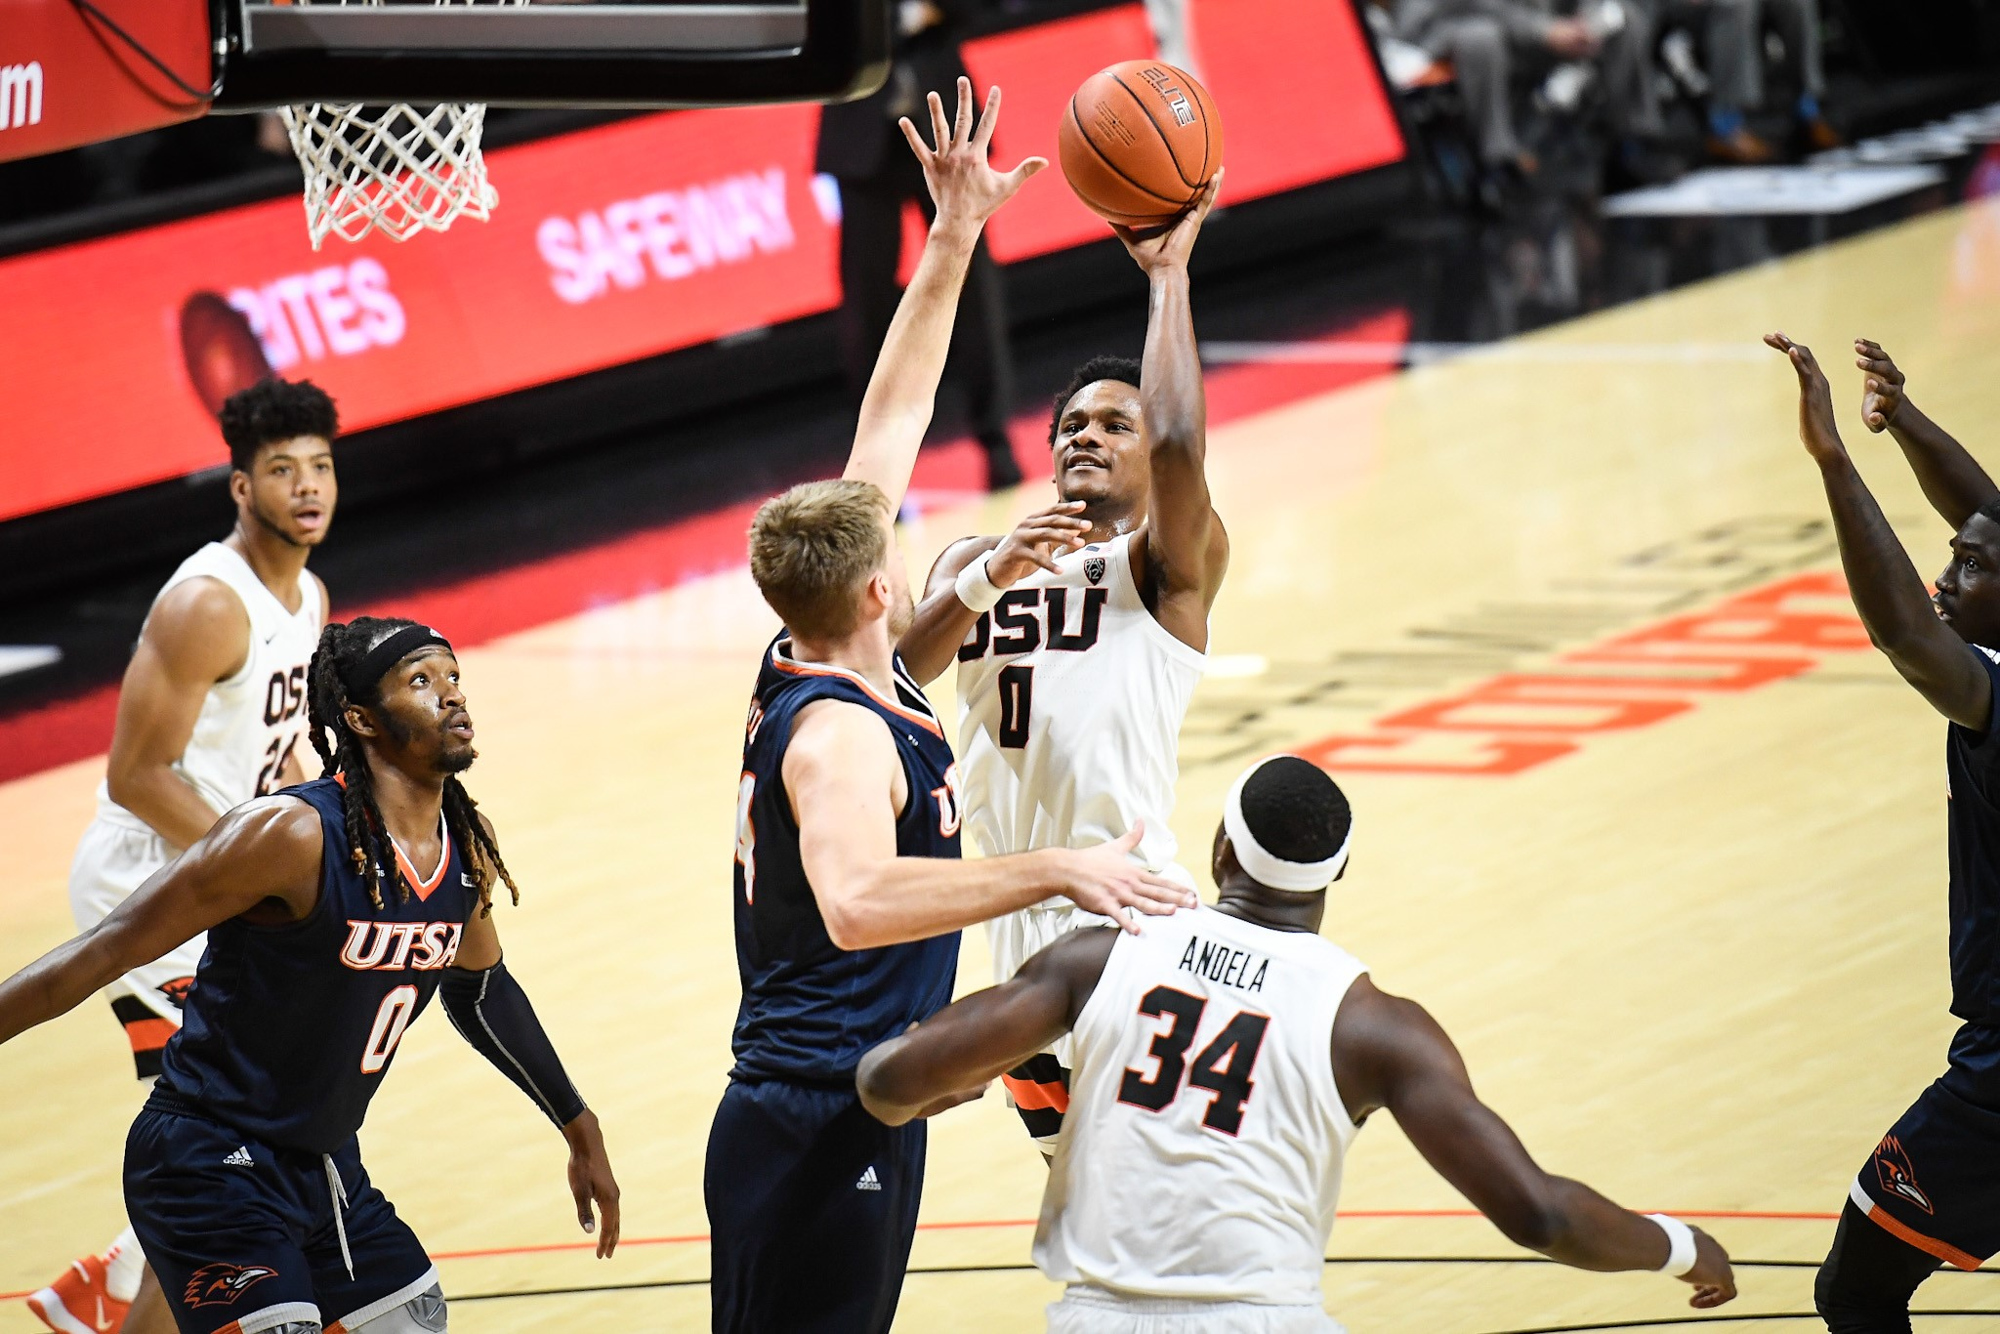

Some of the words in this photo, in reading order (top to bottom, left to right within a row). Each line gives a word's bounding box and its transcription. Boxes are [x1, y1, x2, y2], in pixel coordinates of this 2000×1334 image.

[1143, 66, 1196, 126] ELITE
[536, 164, 796, 304] SAFEWAY
[1088, 569, 1100, 580] 12
[263, 664, 310, 727] OS
[998, 665, 1035, 749] 0
[1179, 935, 1271, 993] ANDELA
[360, 983, 418, 1074] 0
[1116, 984, 1271, 1138] 34
[222, 1157, 255, 1168] adidas
